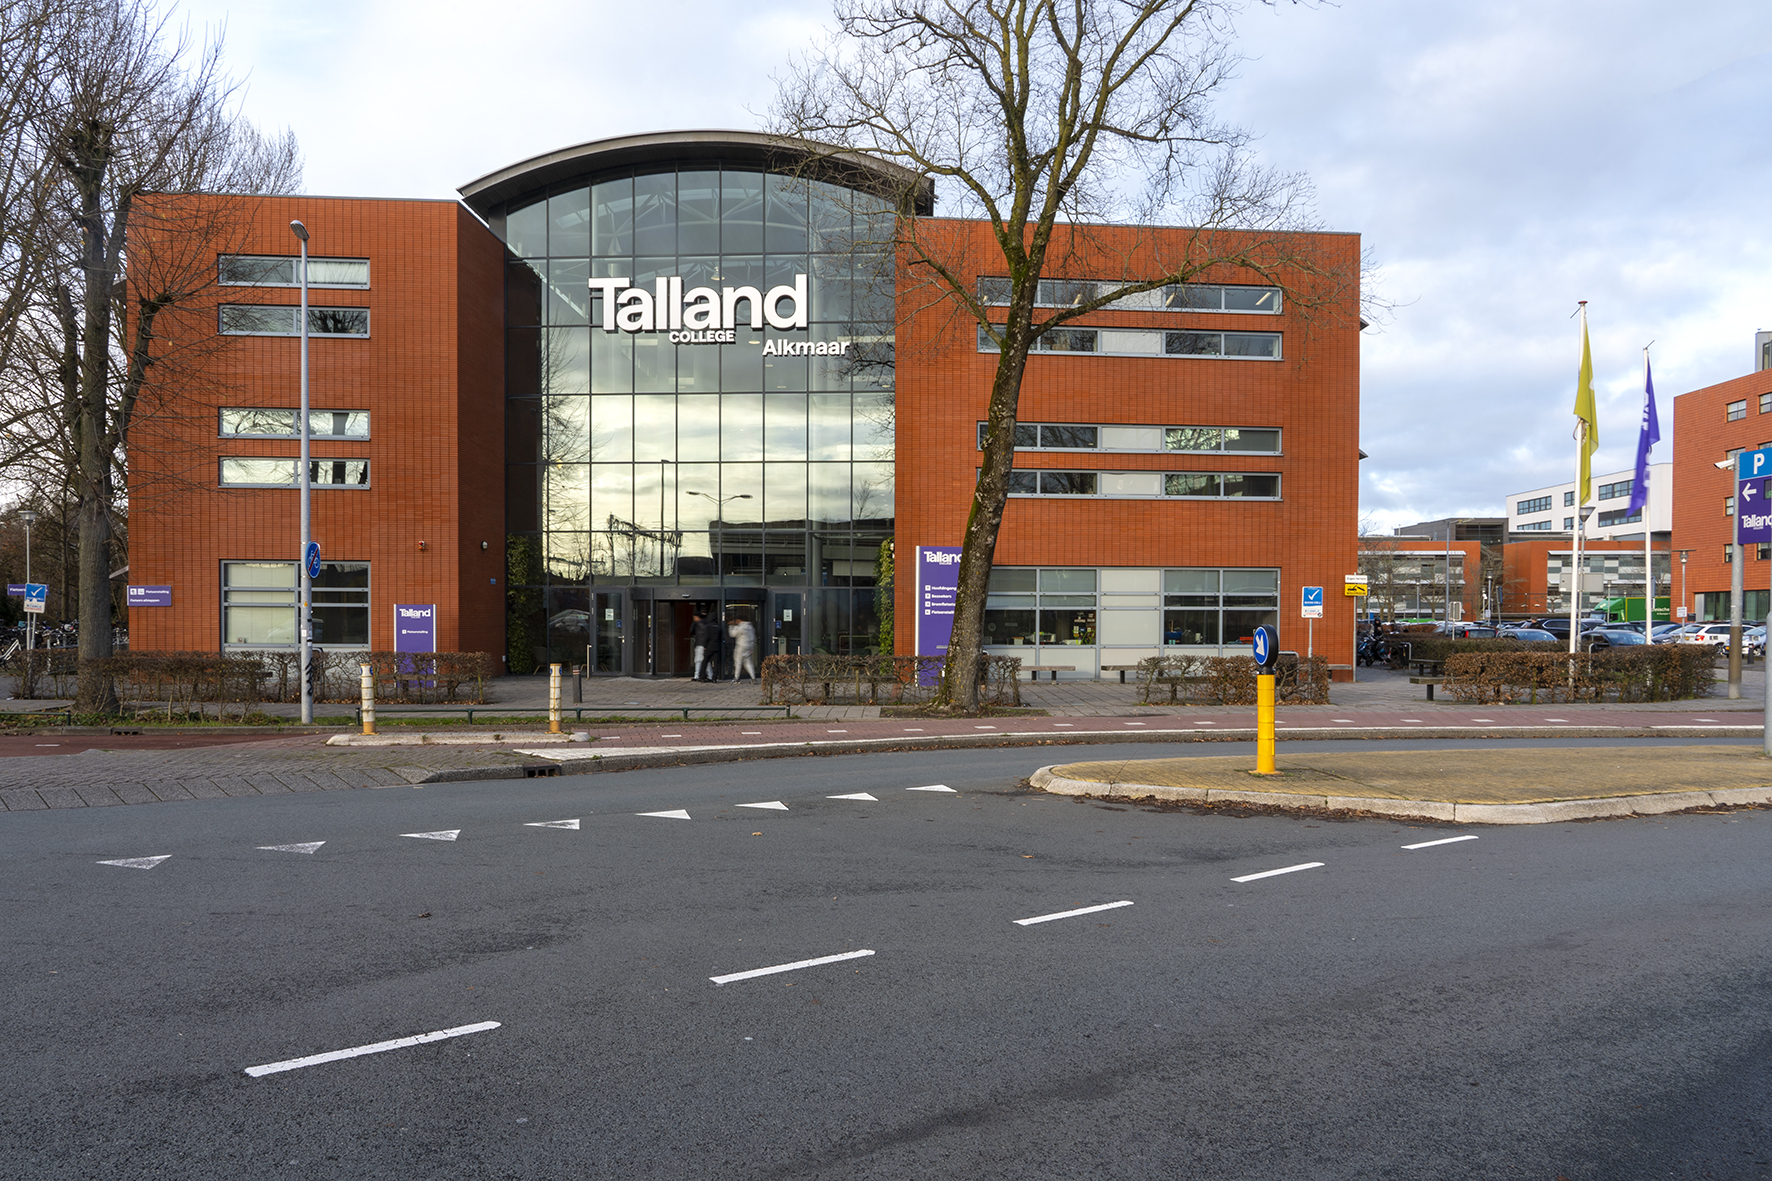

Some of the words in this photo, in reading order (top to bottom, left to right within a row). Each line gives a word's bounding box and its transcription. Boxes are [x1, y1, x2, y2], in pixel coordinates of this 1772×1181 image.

[588, 274, 807, 331] Talland
[669, 330, 735, 343] COLLEGE
[762, 339, 850, 355] Alkmaar
[1753, 453, 1765, 475] P
[399, 608, 431, 616] Talland
